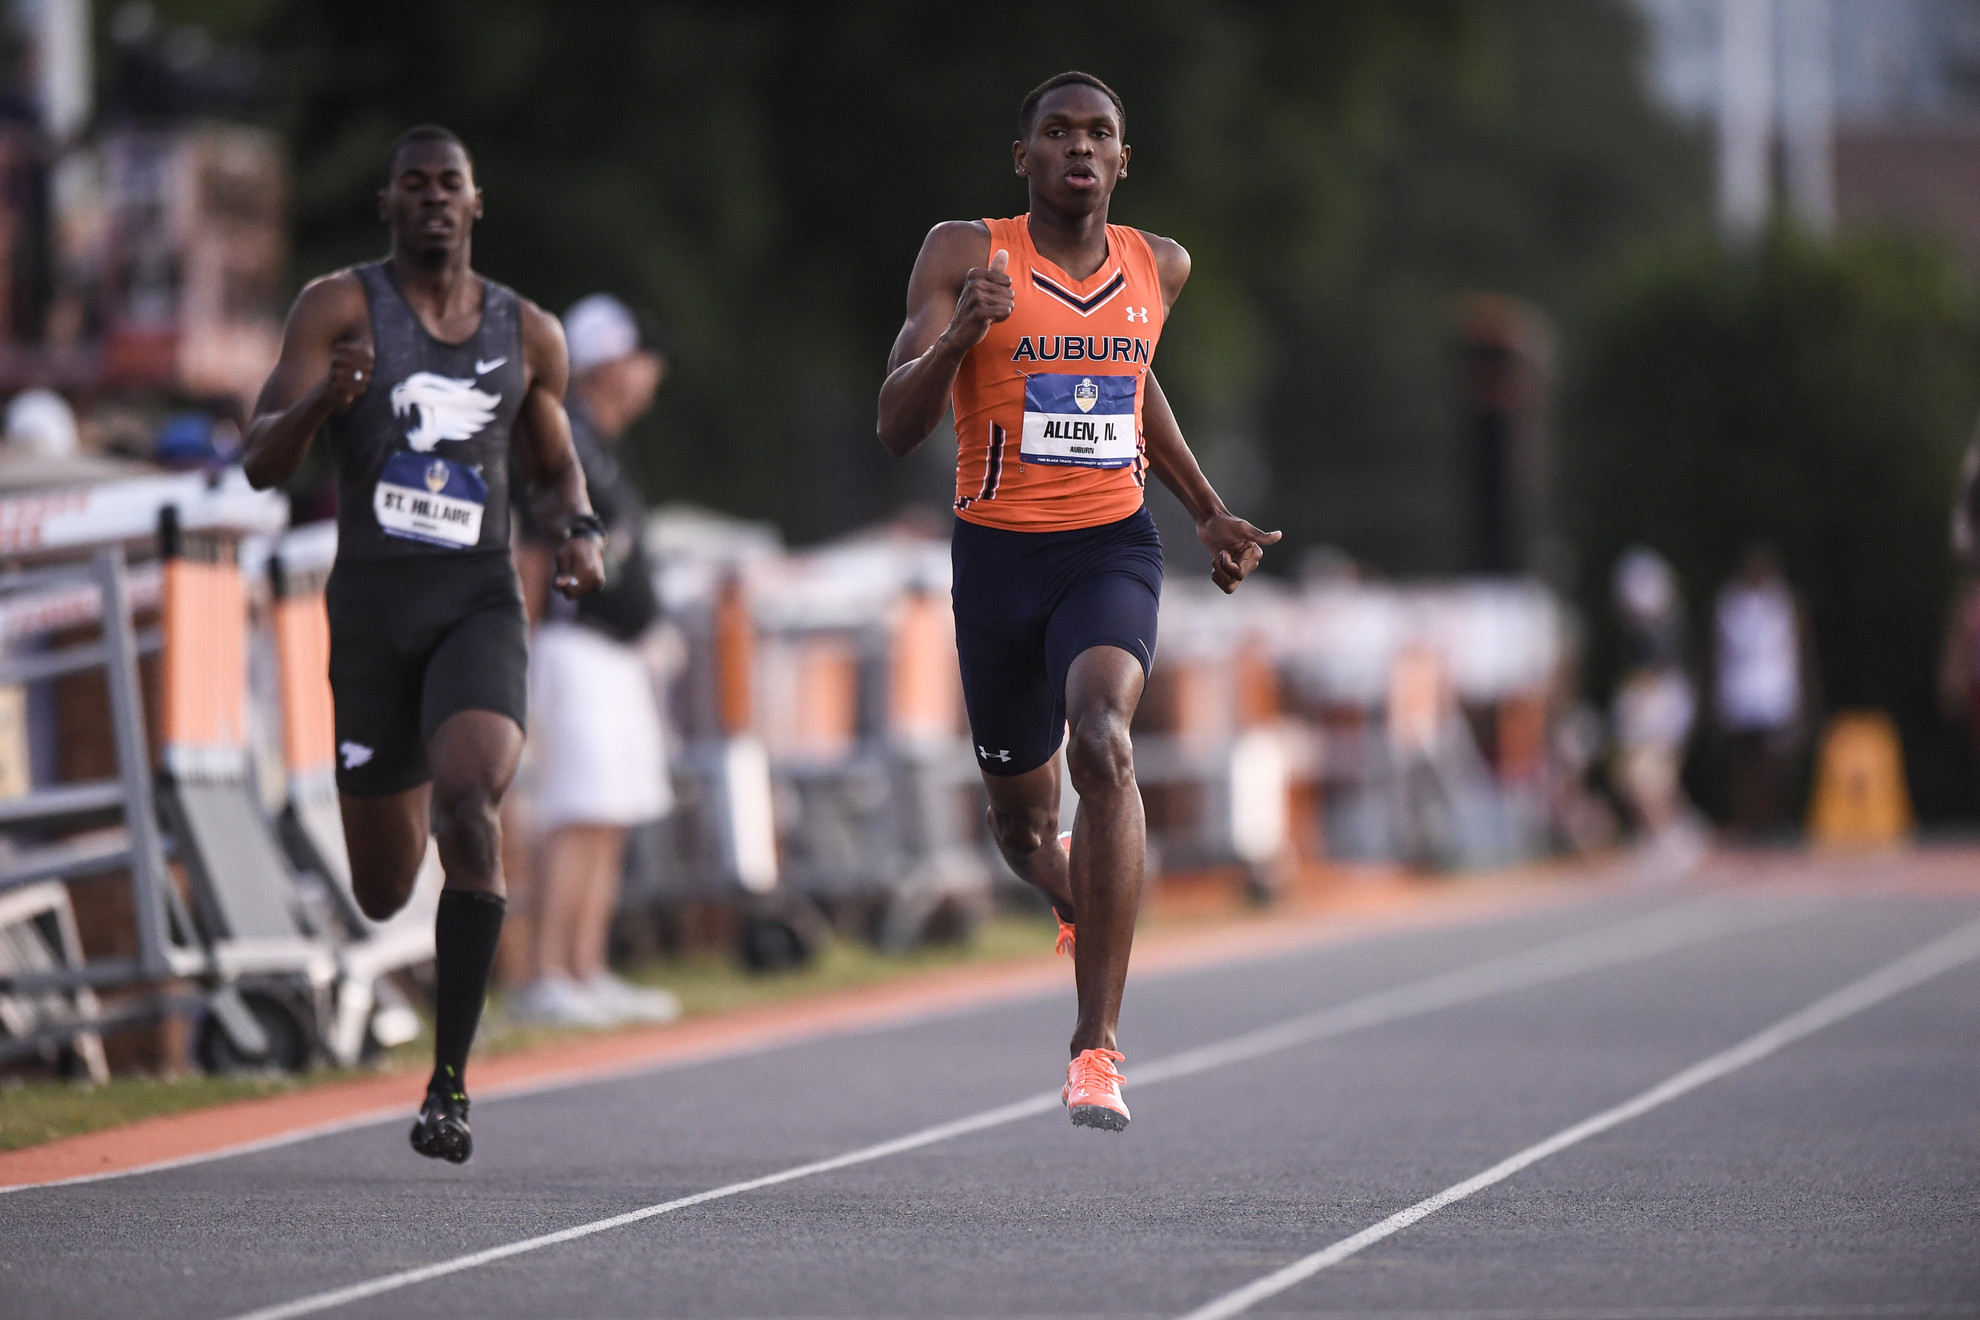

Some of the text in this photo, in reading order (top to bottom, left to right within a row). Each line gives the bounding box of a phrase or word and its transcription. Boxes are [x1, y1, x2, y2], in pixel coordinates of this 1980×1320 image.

[1011, 336, 1150, 365] AUBURN
[1043, 421, 1117, 444] ALLEN, N.
[1069, 446, 1094, 454] AUBURN
[384, 493, 405, 512] ST.
